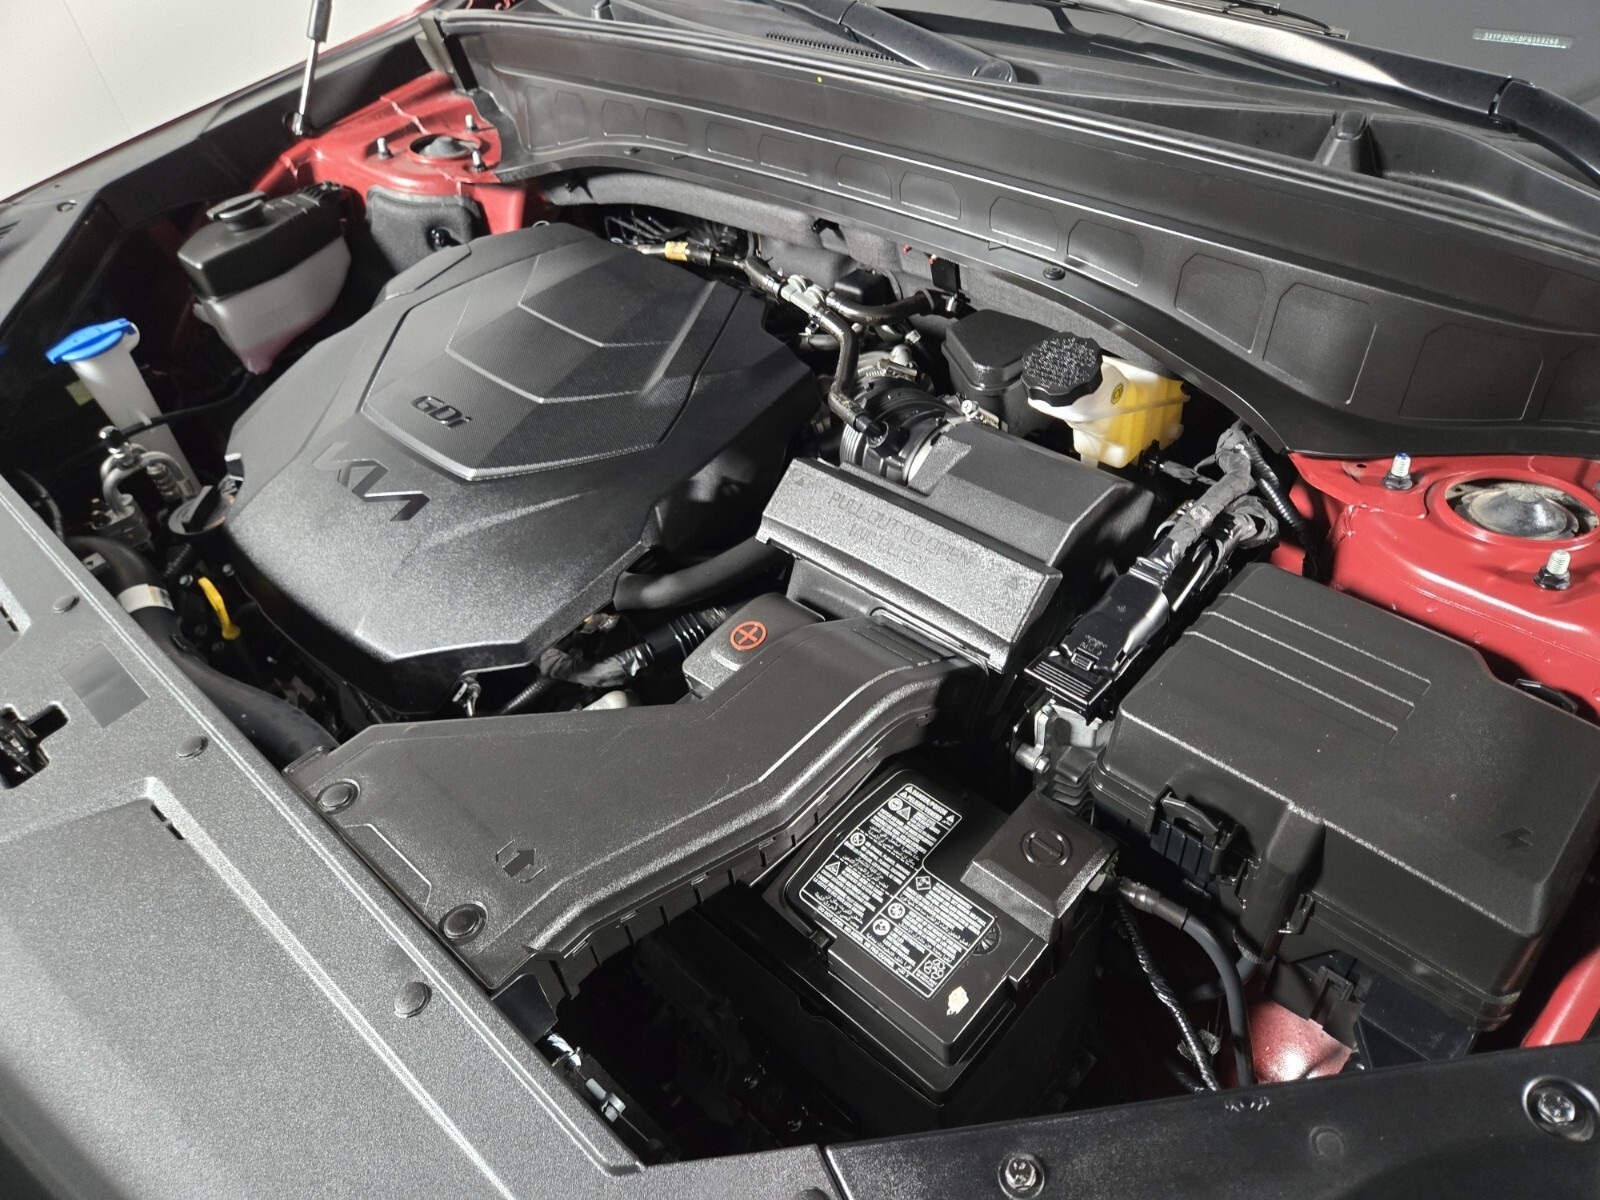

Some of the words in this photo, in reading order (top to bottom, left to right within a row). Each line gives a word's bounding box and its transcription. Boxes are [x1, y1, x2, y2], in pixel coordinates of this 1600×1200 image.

[827, 489, 863, 519] PULL
[865, 508, 902, 536] OUT
[924, 536, 976, 569] OPEN
